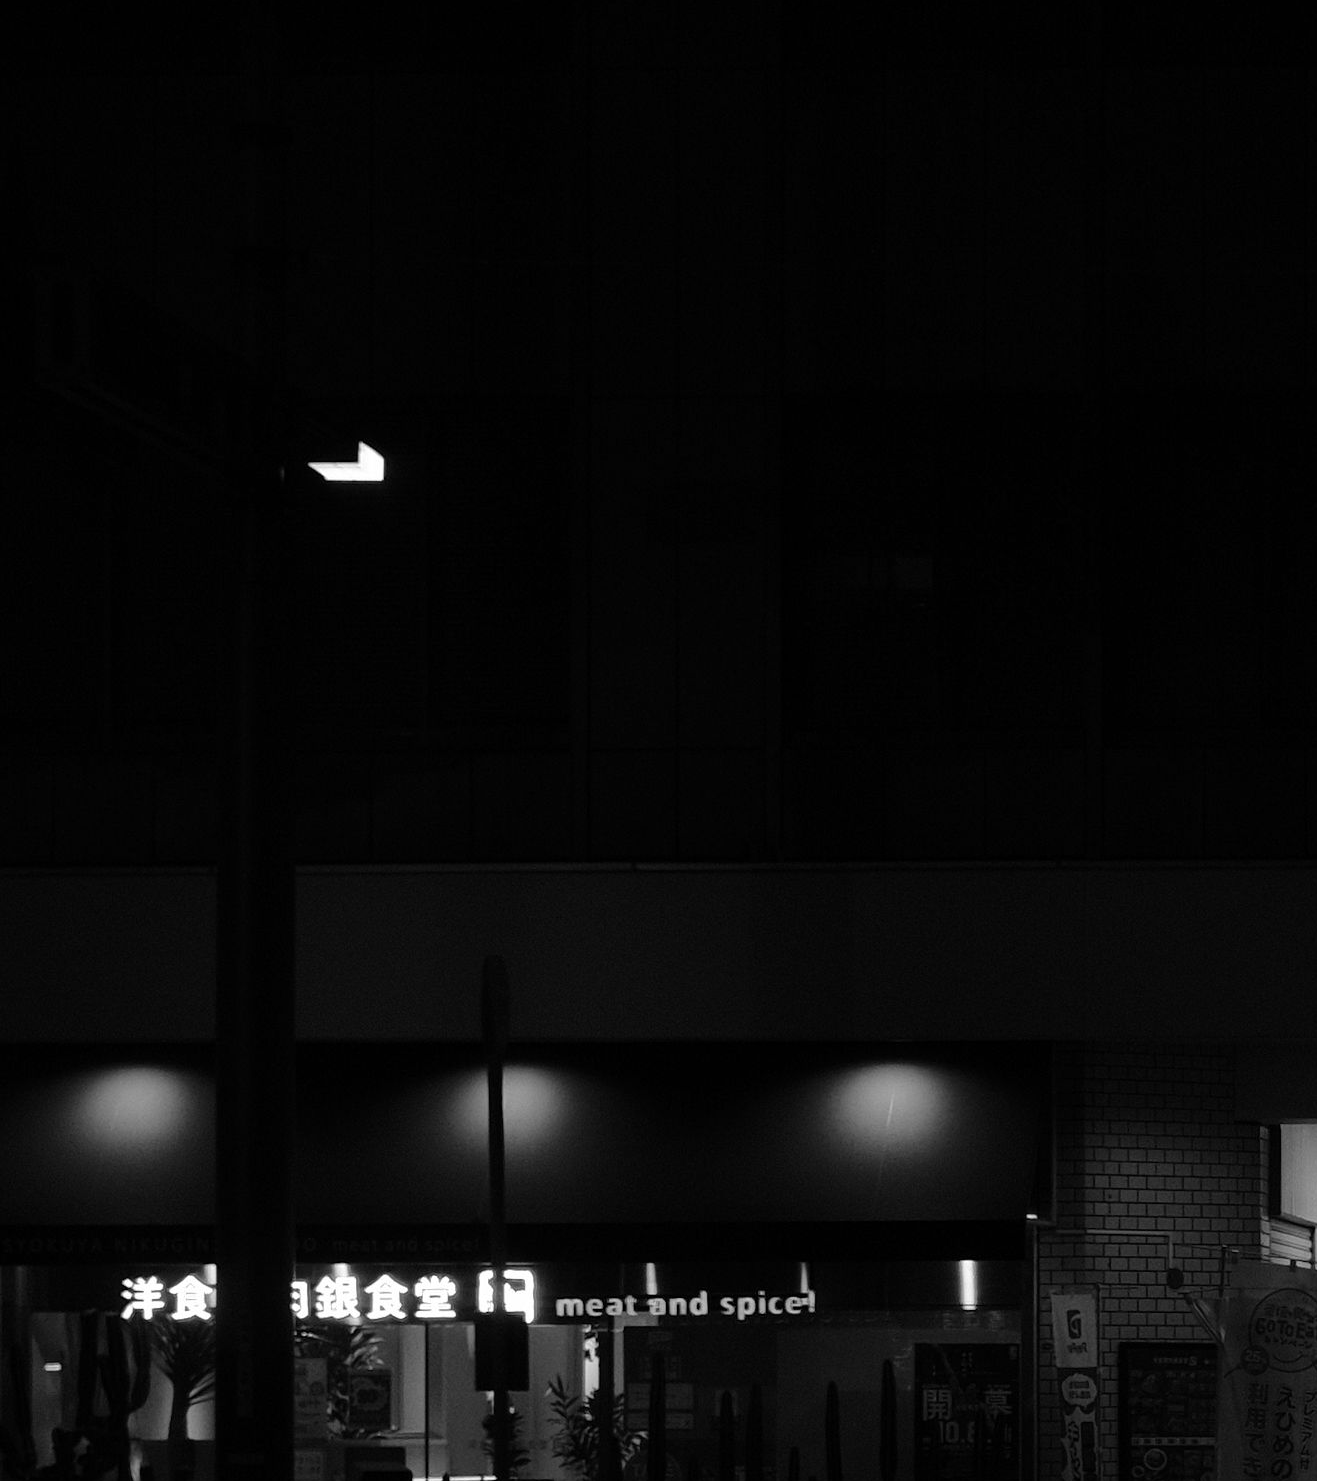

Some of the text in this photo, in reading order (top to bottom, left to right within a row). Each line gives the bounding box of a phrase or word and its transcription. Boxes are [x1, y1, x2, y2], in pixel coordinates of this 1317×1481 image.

[556, 1294, 638, 1317] meat
[648, 1289, 709, 1316] and
[720, 1289, 816, 1321] spice!
[1255, 1317, 1275, 1335] Go
[1277, 1319, 1295, 1337] To
